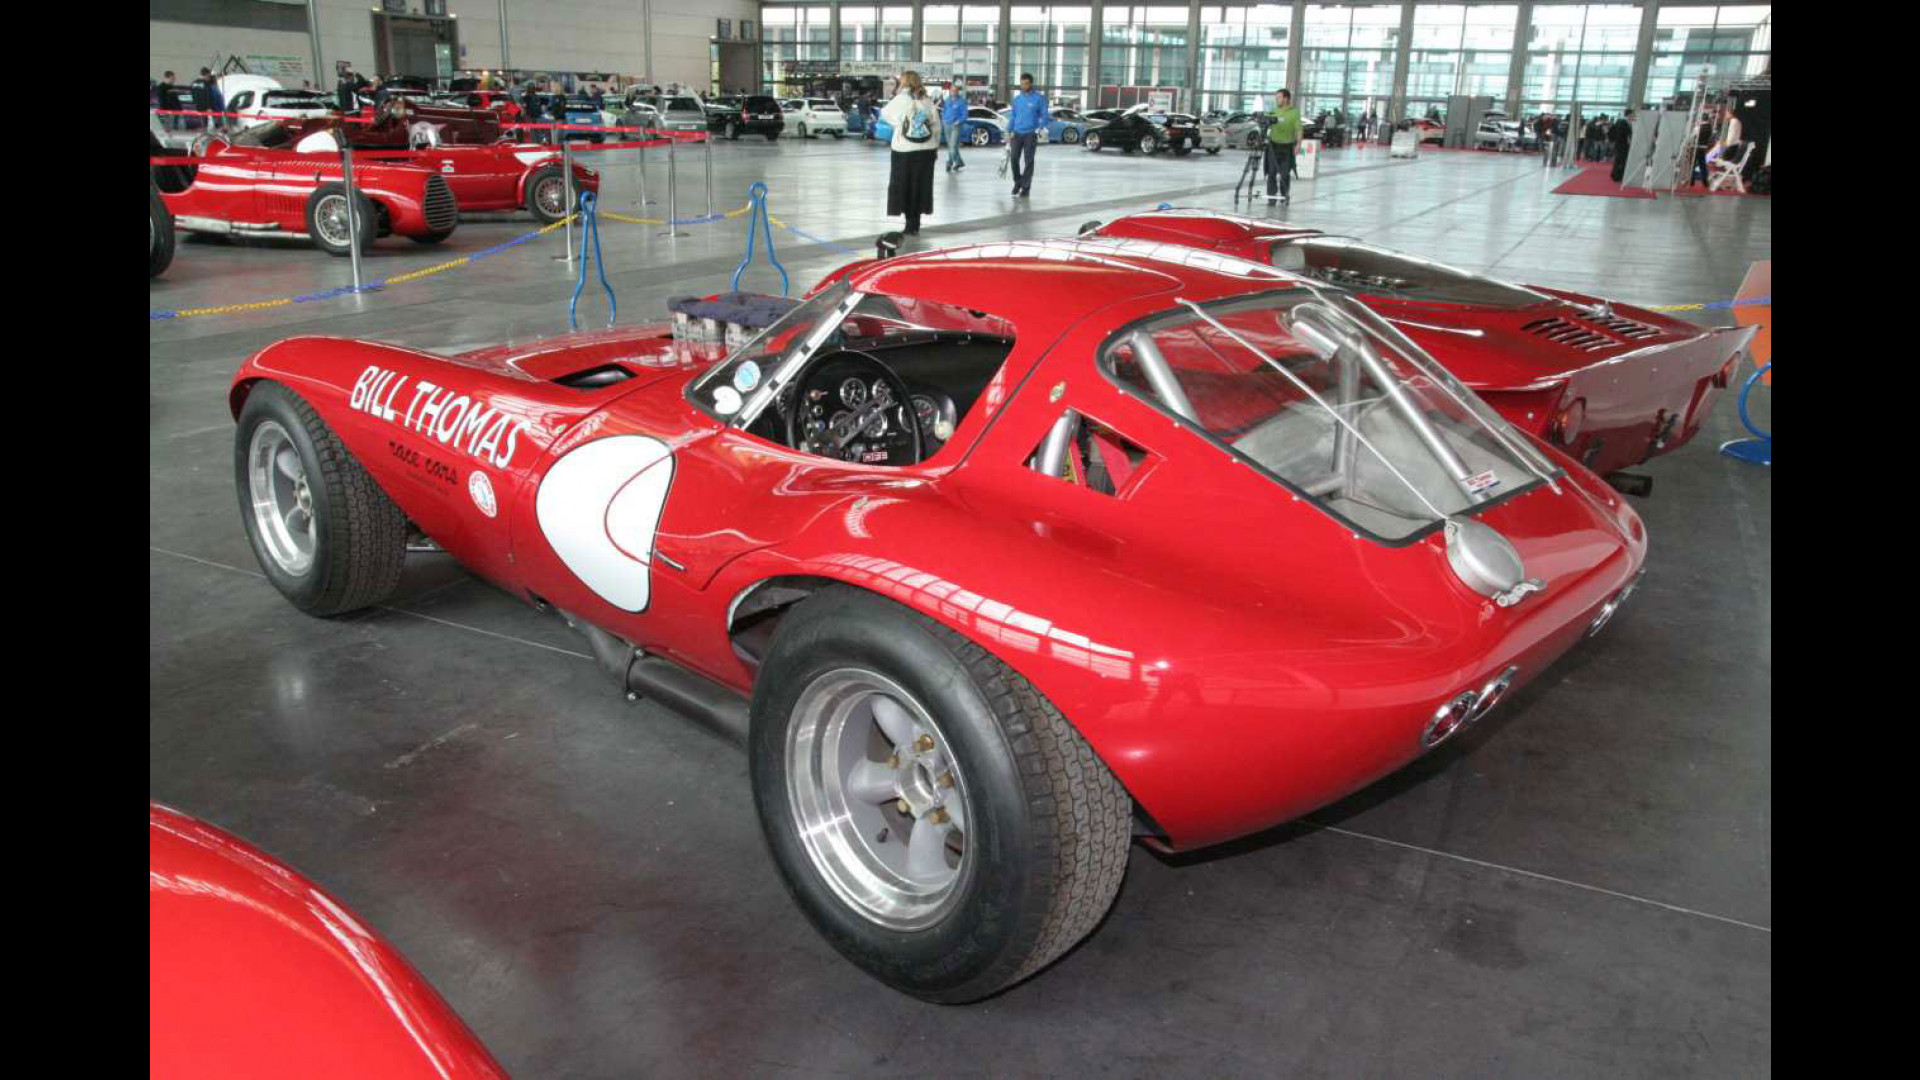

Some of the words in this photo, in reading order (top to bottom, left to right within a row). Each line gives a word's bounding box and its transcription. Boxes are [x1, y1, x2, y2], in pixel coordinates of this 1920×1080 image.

[350, 365, 409, 421] BILL
[404, 381, 531, 468] THOMAS
[389, 441, 419, 467] race
[424, 458, 458, 486] cars
